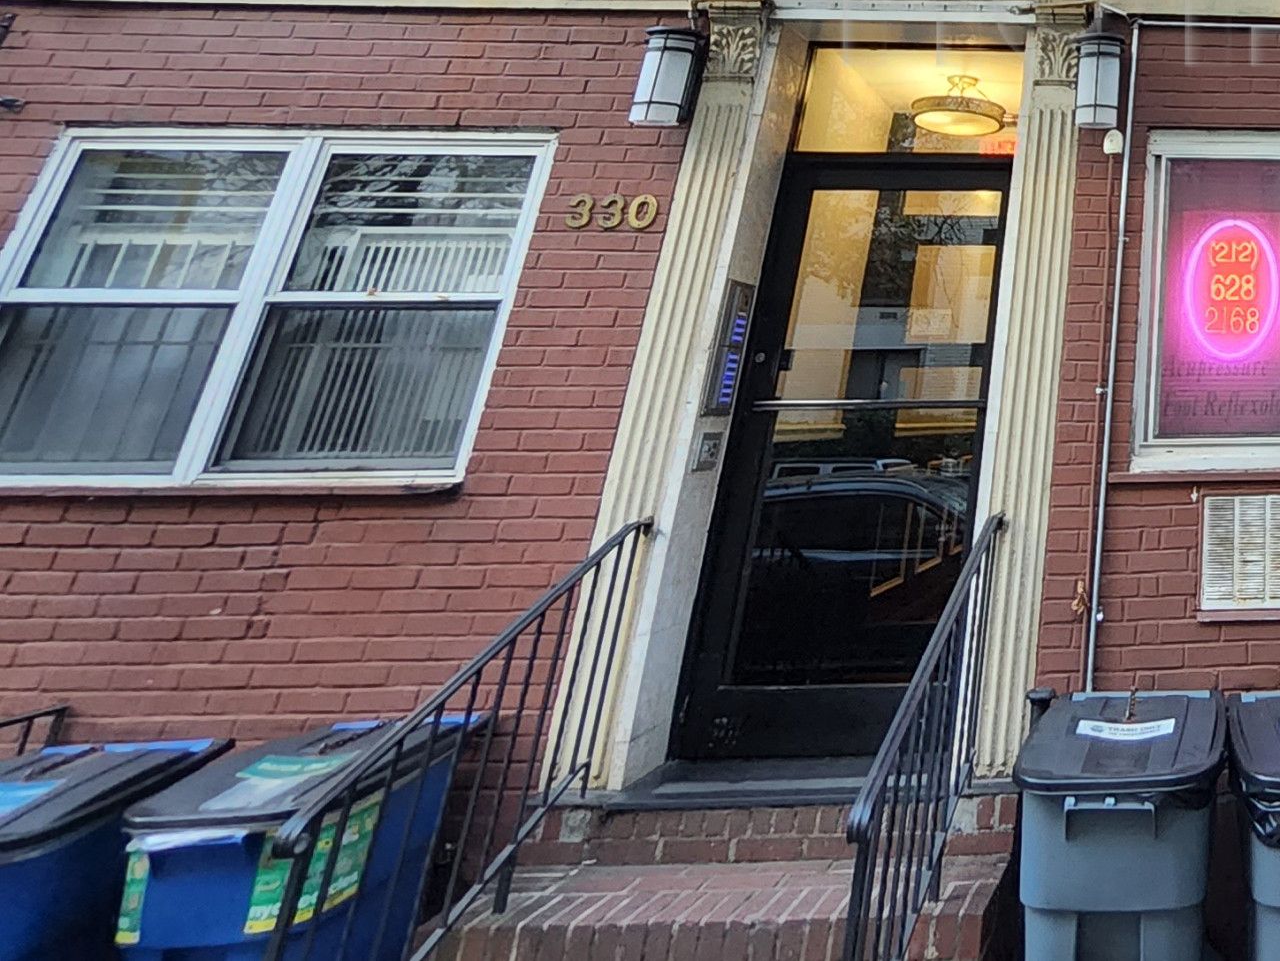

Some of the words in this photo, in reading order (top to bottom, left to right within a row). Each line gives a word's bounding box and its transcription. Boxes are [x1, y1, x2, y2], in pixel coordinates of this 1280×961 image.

[564, 194, 659, 232] 330
[1208, 240, 1259, 271] (212)
[1210, 273, 1256, 301] 628
[1204, 306, 1260, 335] 2168
